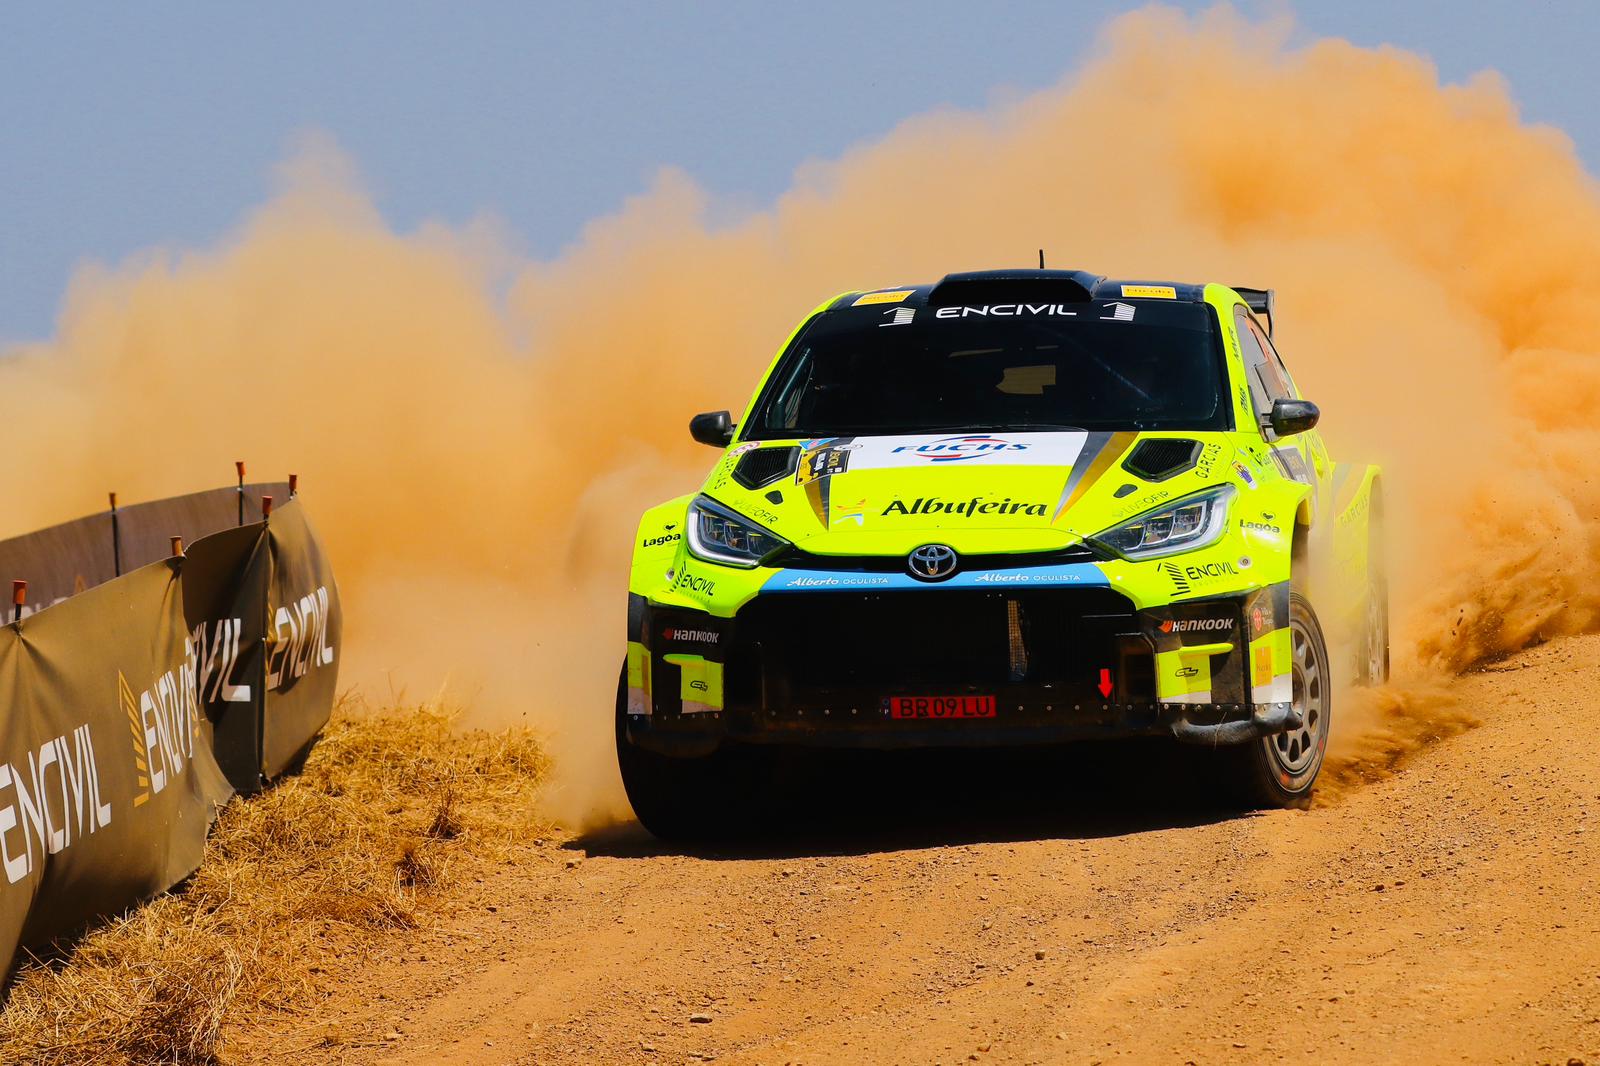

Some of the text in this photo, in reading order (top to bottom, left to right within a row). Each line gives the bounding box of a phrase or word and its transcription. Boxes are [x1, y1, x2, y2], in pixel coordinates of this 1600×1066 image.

[936, 304, 1077, 319] ENCIVIL
[891, 443, 1032, 454] FUCHS
[881, 497, 1048, 518] Albufeira
[1239, 519, 1281, 534] Lagoa
[643, 533, 681, 548] Lagoa
[974, 572, 1081, 583] Alberto OCULISTA
[1185, 562, 1239, 580] ENCIVIL
[680, 574, 716, 597] ENCIVIL
[786, 576, 889, 587] Alberto OCULISTA
[267, 585, 333, 691] ENCIVIL
